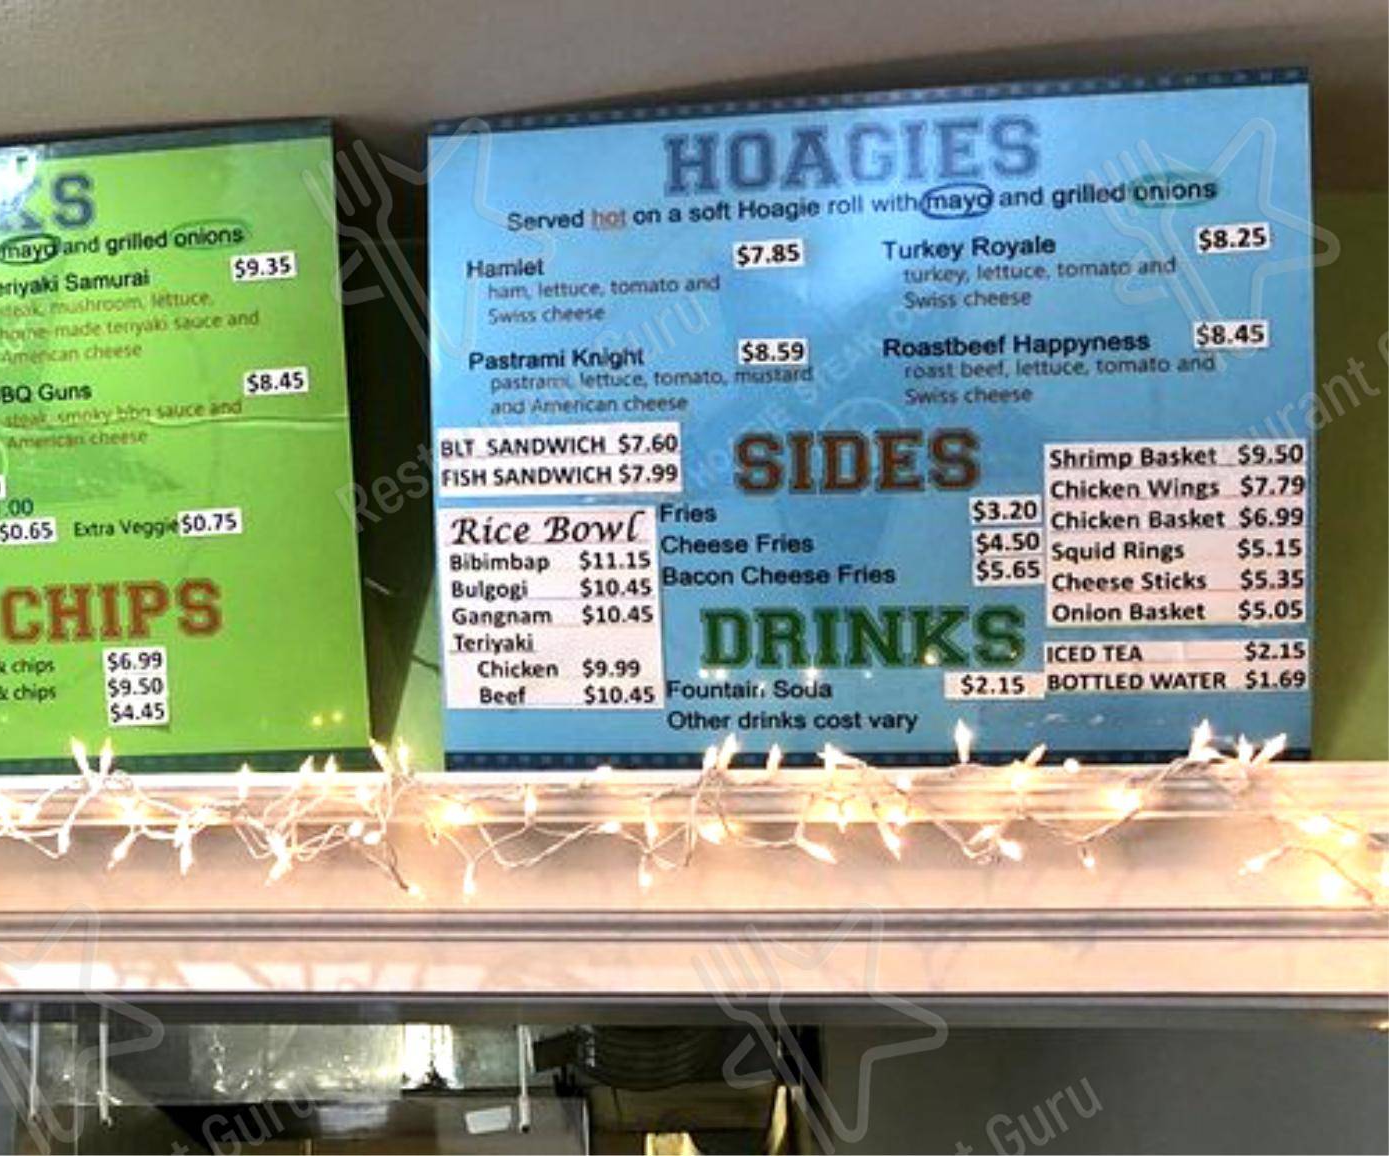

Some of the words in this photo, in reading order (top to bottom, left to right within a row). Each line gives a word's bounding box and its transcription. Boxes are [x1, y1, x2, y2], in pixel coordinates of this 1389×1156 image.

[665, 113, 1040, 196] HOAGIES
[883, 241, 964, 261] Turkey
[973, 236, 1055, 259] Royale
[1199, 227, 1267, 251] $8.25
[737, 244, 800, 266] $7.85
[235, 257, 291, 278] $9.35
[467, 259, 544, 280] Hamlet
[1058, 259, 1130, 277] tomato
[1138, 257, 1176, 274] and
[65, 270, 150, 291] Samurai
[1196, 324, 1265, 346] $8.45
[742, 342, 804, 362] $8.59
[883, 334, 1006, 358] Roastbeef
[1014, 334, 1150, 358] Happyness
[469, 350, 565, 371] Pastrami
[572, 348, 644, 371] Knight
[37, 383, 92, 401] Guns
[247, 372, 304, 392] $8.45
[441, 440, 474, 457] BLT
[488, 436, 605, 456] SANDWICH
[619, 433, 677, 454] $7.60
[734, 428, 981, 494] SIDES
[1050, 449, 1131, 469] Shrimp
[1141, 447, 1217, 466] Basket
[1238, 444, 1303, 465] $9.50
[441, 469, 486, 486] FISH
[494, 466, 611, 486] SANDWICH
[619, 465, 677, 484] $7.99
[1051, 480, 1141, 499] Chicken
[1148, 479, 1220, 500] Wings
[1241, 476, 1305, 496] $7.79
[74, 521, 114, 537] Extra
[182, 512, 237, 533] $0.75
[451, 516, 530, 545] Rice
[545, 511, 645, 544] Bowl
[1052, 512, 1141, 530] Chicken
[1148, 511, 1225, 529] Basket
[1240, 508, 1304, 528] $6.99
[661, 535, 748, 554] Cheese
[757, 534, 815, 553] Fries
[977, 532, 1040, 554] $4.50
[1052, 542, 1115, 563] Squid
[1124, 541, 1185, 563] Rings
[1238, 538, 1301, 560] $5.15
[450, 554, 550, 573] Bibimbap
[580, 552, 650, 570] $11.15
[977, 560, 1041, 581] $5.65
[662, 567, 734, 586] Bacon
[742, 566, 830, 585] Cheese
[838, 565, 896, 583] Fries
[1052, 574, 1134, 591] Cheese
[1141, 571, 1206, 590] Sticks
[1241, 569, 1304, 591] $5.35
[451, 580, 528, 601] Bulgogi
[580, 579, 652, 597] $10.45
[0, 577, 223, 645] CHIPS
[452, 609, 552, 627] Gangnam
[583, 606, 653, 625] $10.45
[1053, 605, 1121, 623] Onion
[1130, 602, 1205, 620] Basket
[1239, 600, 1303, 622] $5.05
[700, 604, 1026, 669] DRINKS
[107, 652, 161, 671] $6.99
[1047, 646, 1096, 663] ICED
[1106, 645, 1142, 661] TEA
[1246, 642, 1305, 661] $2.15
[12, 658, 54, 674] chips
[478, 662, 558, 678] Chicken
[583, 660, 639, 679] $9.99
[108, 678, 162, 697] $9.50
[961, 677, 1025, 695] $2.15
[1047, 674, 1143, 690] BOTTLED
[1151, 673, 1225, 690] WATER
[1246, 670, 1305, 690] $1.69
[14, 684, 56, 700] chips
[479, 687, 525, 704] Beef
[585, 686, 655, 705] $10.45
[110, 703, 165, 722] $4.45
[667, 710, 729, 729] Other
[738, 709, 806, 729] drinks
[814, 712, 862, 728] cost
[867, 713, 917, 731] vary
